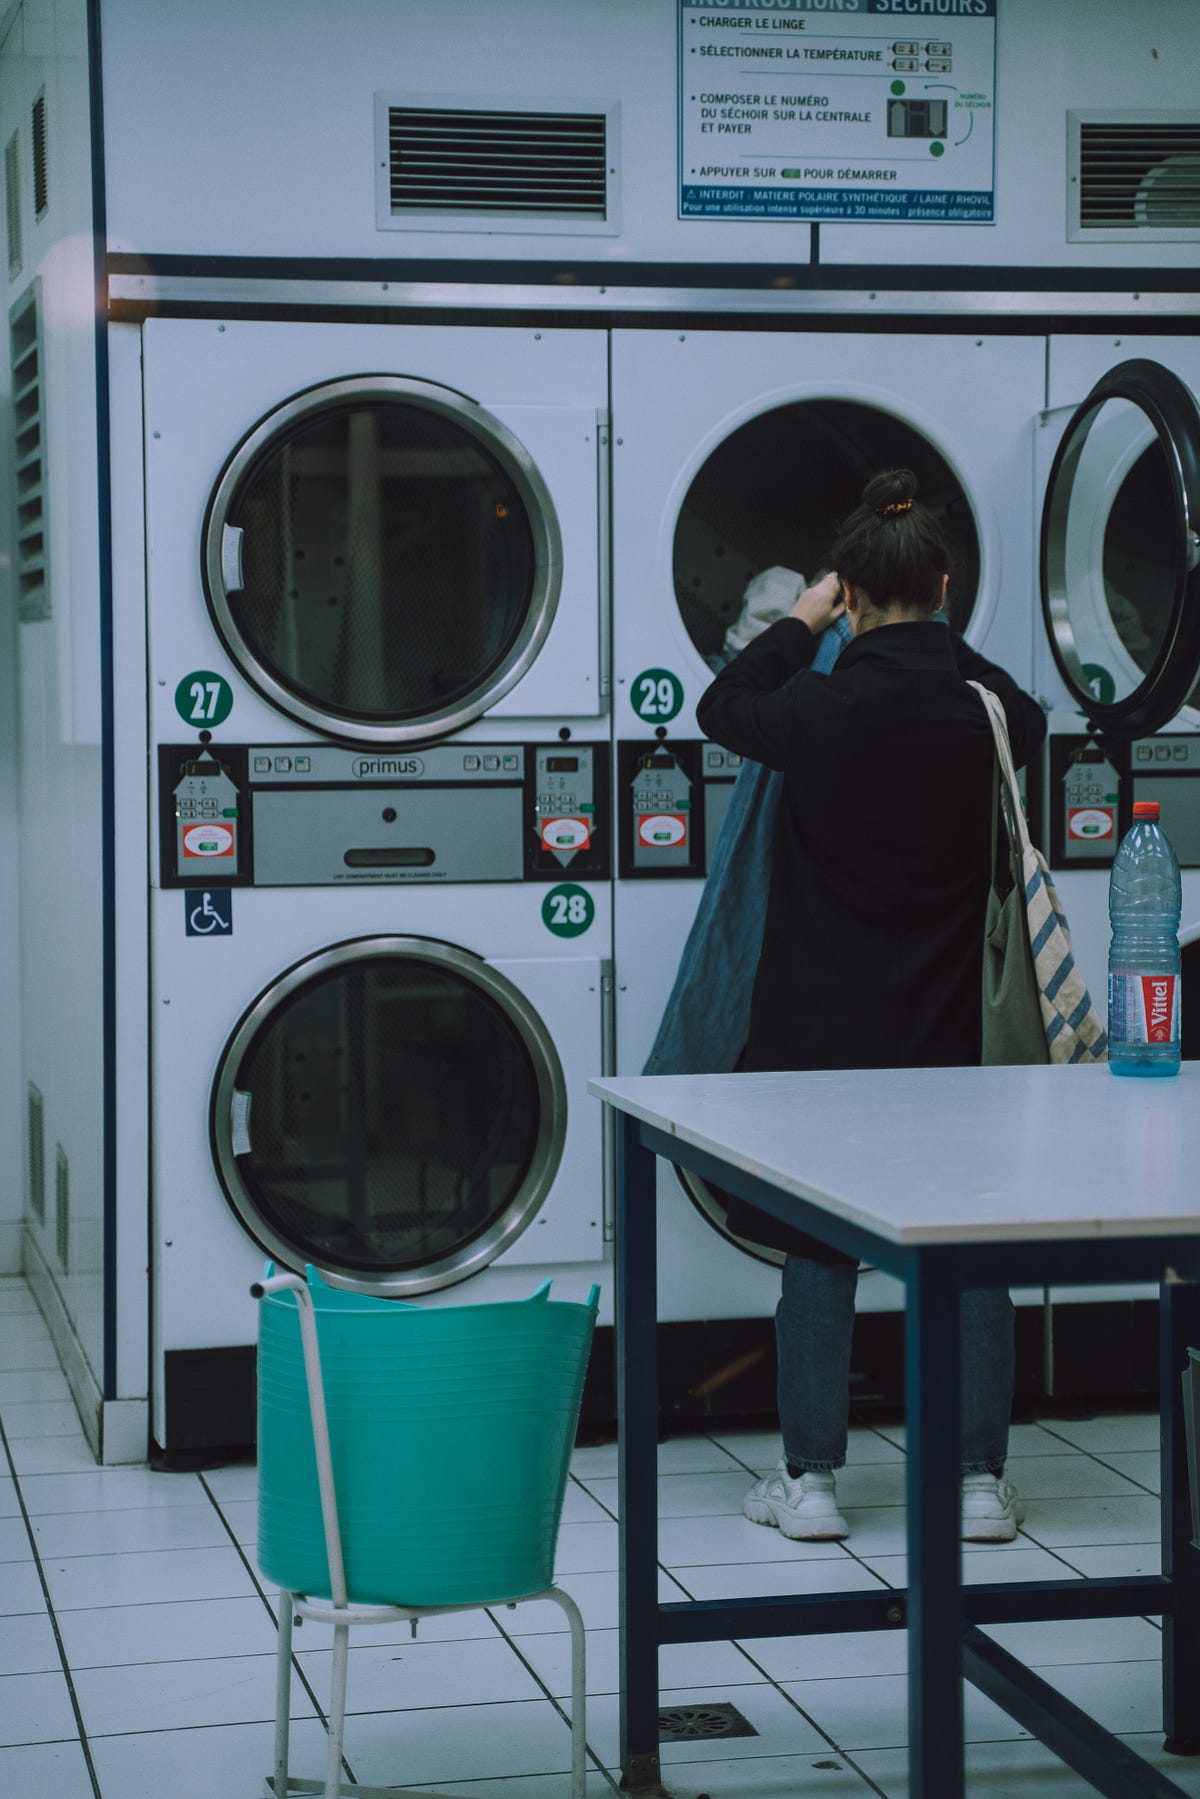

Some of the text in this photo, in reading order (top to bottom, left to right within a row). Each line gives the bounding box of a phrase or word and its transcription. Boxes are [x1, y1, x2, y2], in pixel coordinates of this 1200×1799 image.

[699, 16, 806, 30] CHARGER LE LINGE
[699, 45, 882, 61] SÉLECTIONNER LA TEMPÉRATURE
[700, 93, 829, 107] COMPOSER LE NUMÉRO
[701, 107, 872, 122] DU SÉCHOIR SUR LA CENTRALE
[701, 123, 752, 134] ET PAYER
[699, 166, 897, 181] APPUYER SUR POUR DÉMARRER
[699, 190, 745, 200] INTERDIT
[798, 192, 839, 202] POLAIRE
[842, 192, 908, 204] SYNTHÉTIQUE
[920, 194, 948, 204] LAINE
[683, 201, 703, 211] Pour
[705, 203, 721, 212] une
[723, 202, 765, 213] utilisation
[767, 203, 798, 213] intense
[854, 206, 866, 215] 30
[868, 206, 900, 216] minutes
[189, 682, 222, 720] 27
[639, 678, 675, 715] 29
[358, 757, 418, 776] primus
[549, 894, 587, 924] 28
[1151, 981, 1168, 1026] Vittel
